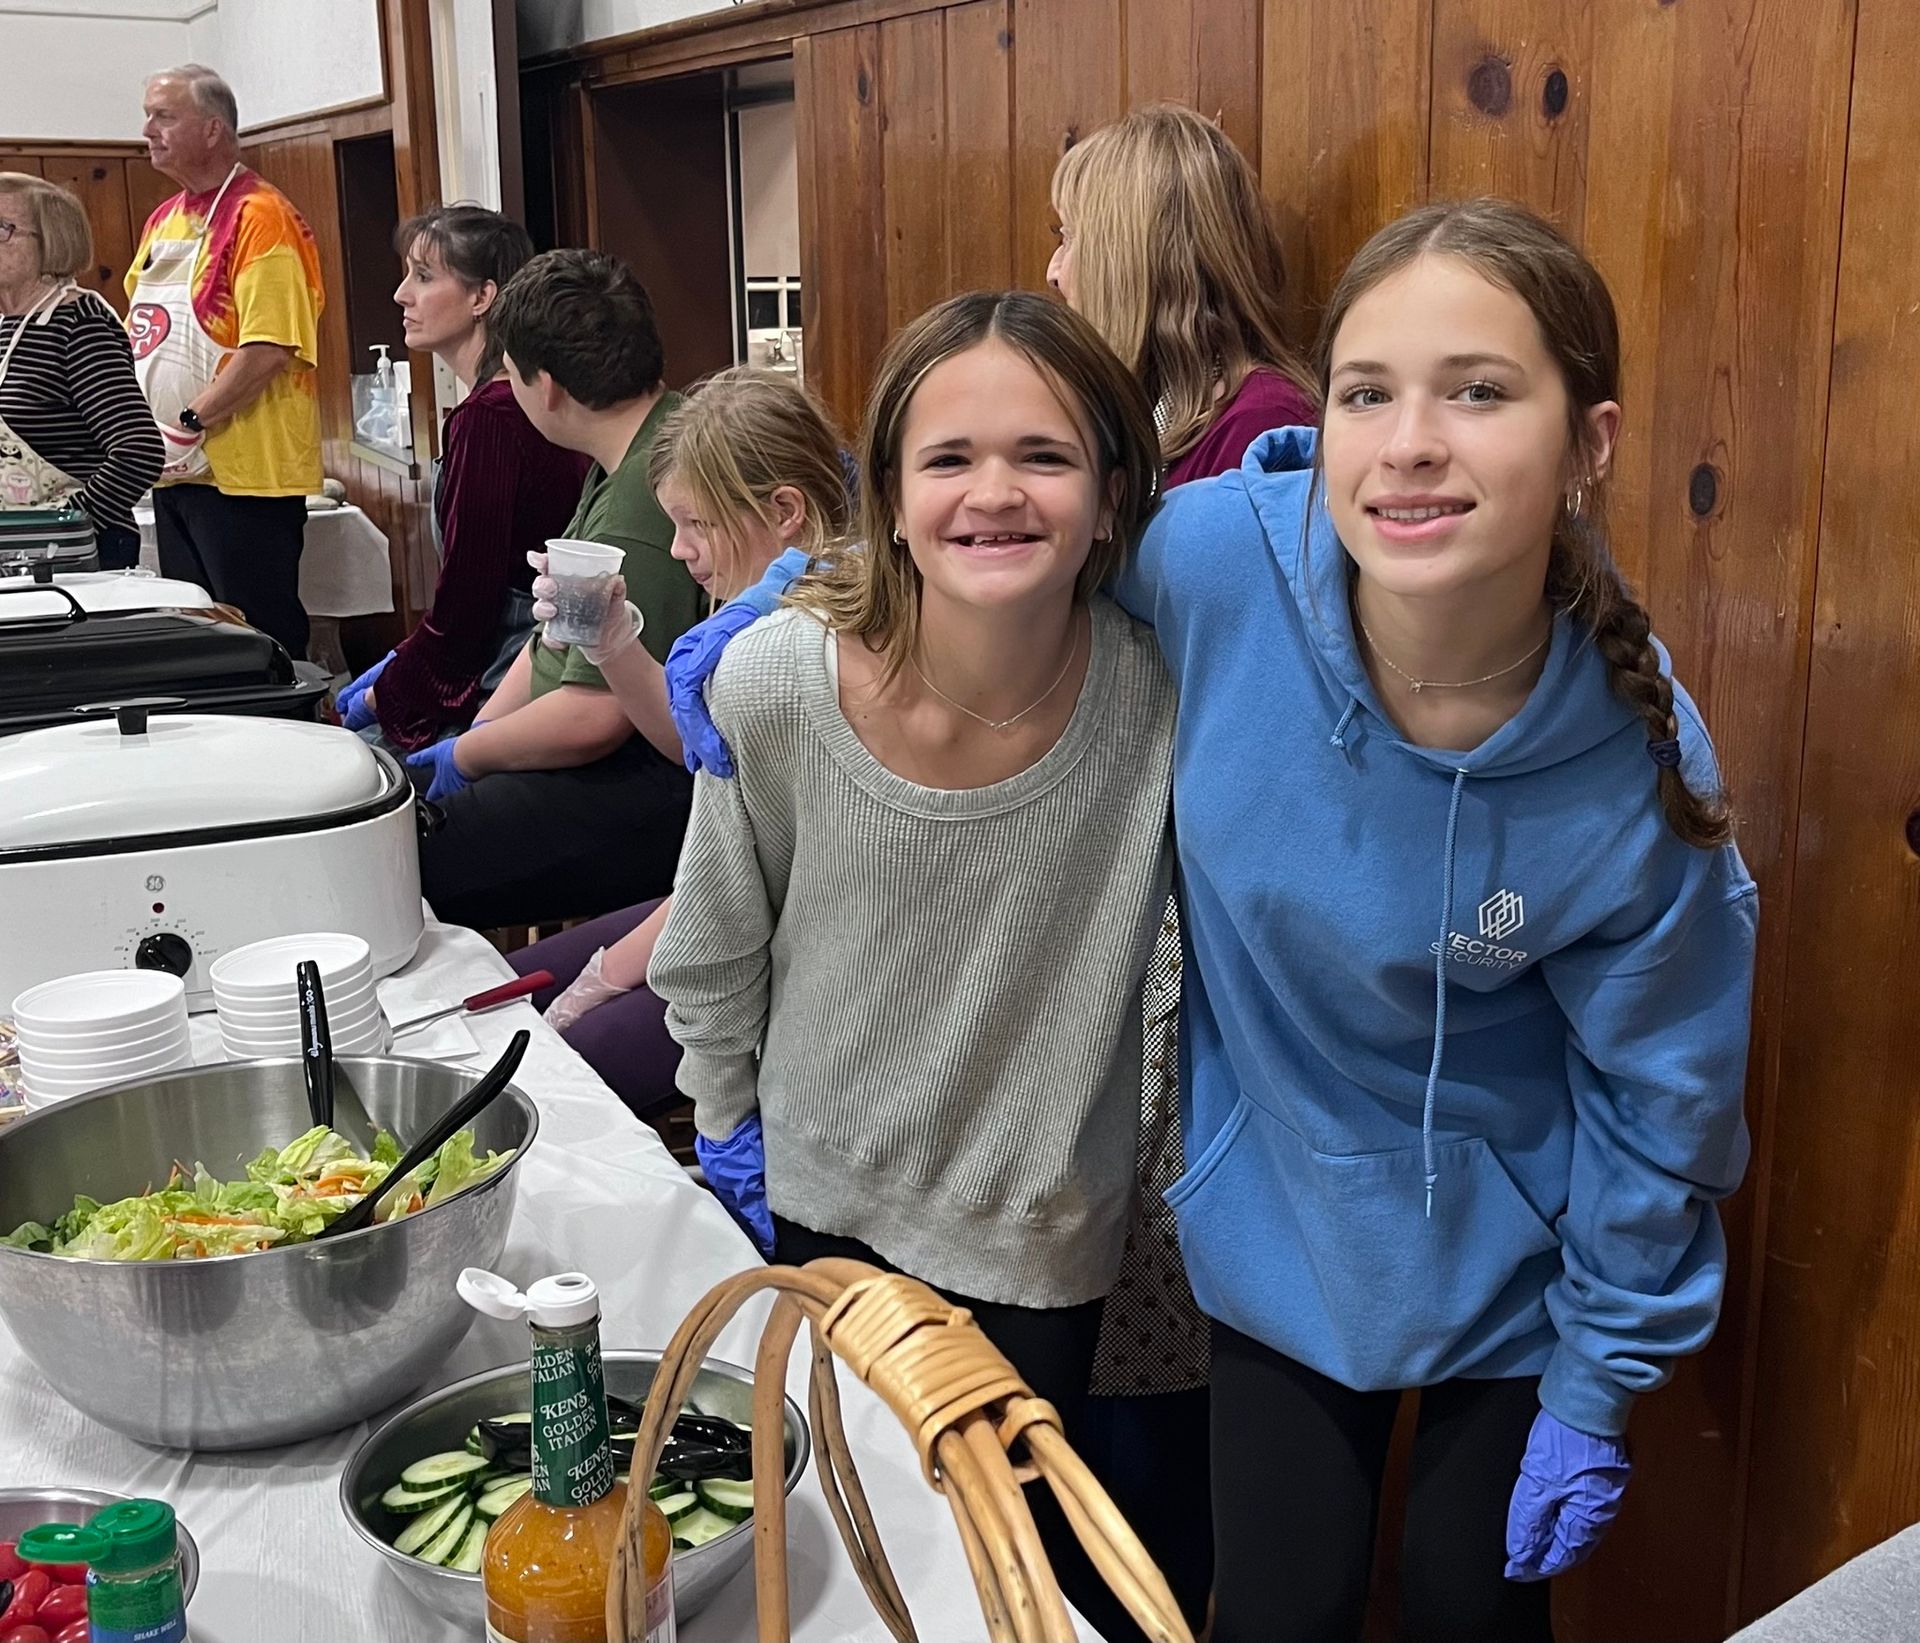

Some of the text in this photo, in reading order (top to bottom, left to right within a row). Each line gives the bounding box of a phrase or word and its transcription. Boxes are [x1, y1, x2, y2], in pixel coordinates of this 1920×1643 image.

[1448, 931, 1528, 962] ECTOR
[532, 1348, 574, 1369] OLDEN
[532, 1361, 576, 1384] TALIAN
[542, 1402, 596, 1438] GOLDEN
[548, 1414, 598, 1451] ITALIAN
[133, 1619, 177, 1642] SHAKE WELL
